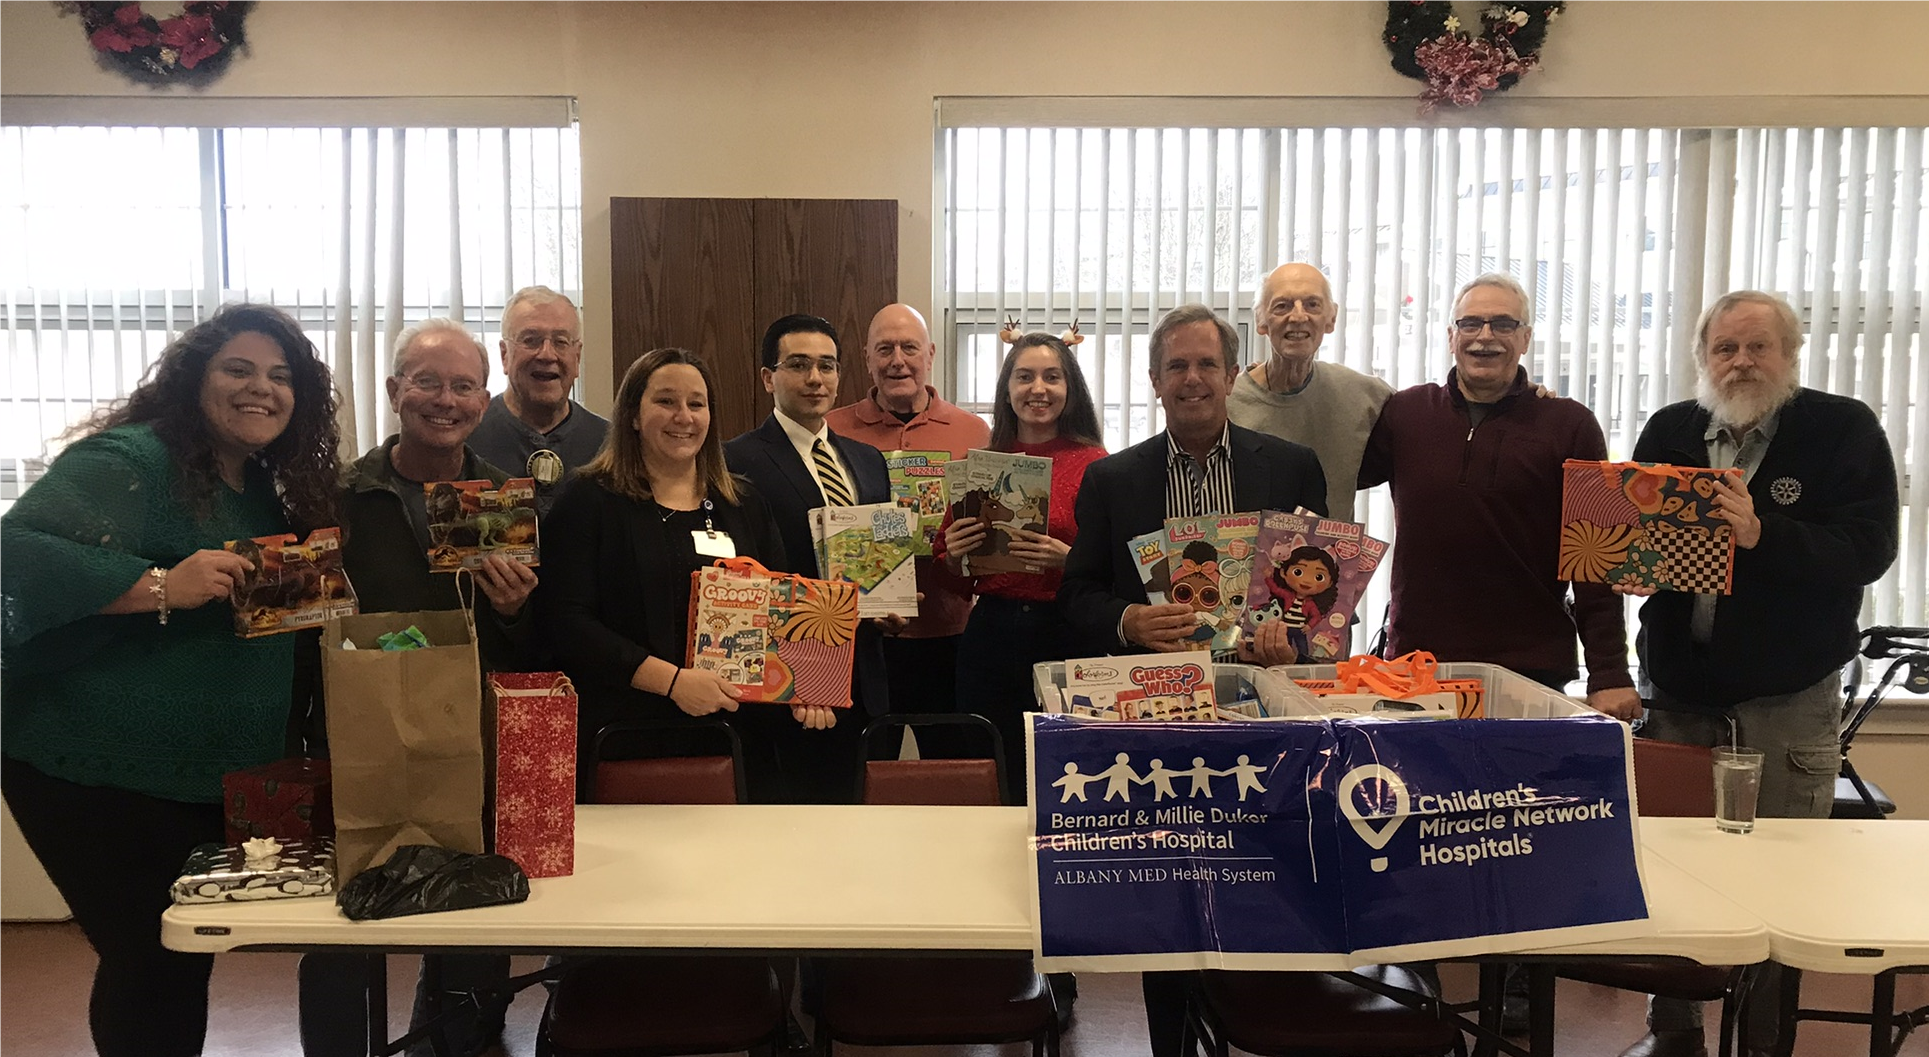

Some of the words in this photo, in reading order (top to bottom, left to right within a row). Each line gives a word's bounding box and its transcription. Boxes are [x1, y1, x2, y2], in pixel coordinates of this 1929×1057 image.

[886, 457, 927, 469] STICKER
[905, 466, 946, 476] PUZZLES
[1012, 459, 1047, 470] JUMBO
[871, 508, 907, 525] Chutes
[1216, 516, 1259, 529] JUMBO
[873, 523, 909, 542] Ladders
[1317, 520, 1360, 536] JUMBO
[1136, 541, 1160, 557] TOY
[704, 584, 767, 605] GROOVY
[1130, 666, 1183, 682] Guess
[1144, 663, 1204, 696] Who?
[1418, 783, 1537, 814] Children's
[1051, 810, 1129, 829] Bernard
[1135, 809, 1149, 826] &
[1155, 806, 1205, 825] Millie
[1419, 811, 1506, 839] Miracle
[1513, 798, 1615, 828] Network
[1051, 831, 1147, 852] Children's
[1153, 830, 1235, 853] Hospital
[1419, 833, 1533, 866] Hospitals
[1054, 870, 1123, 885] ALBANY
[1128, 869, 1168, 883] MED
[1172, 866, 1218, 882] Health
[1221, 867, 1276, 885] System
